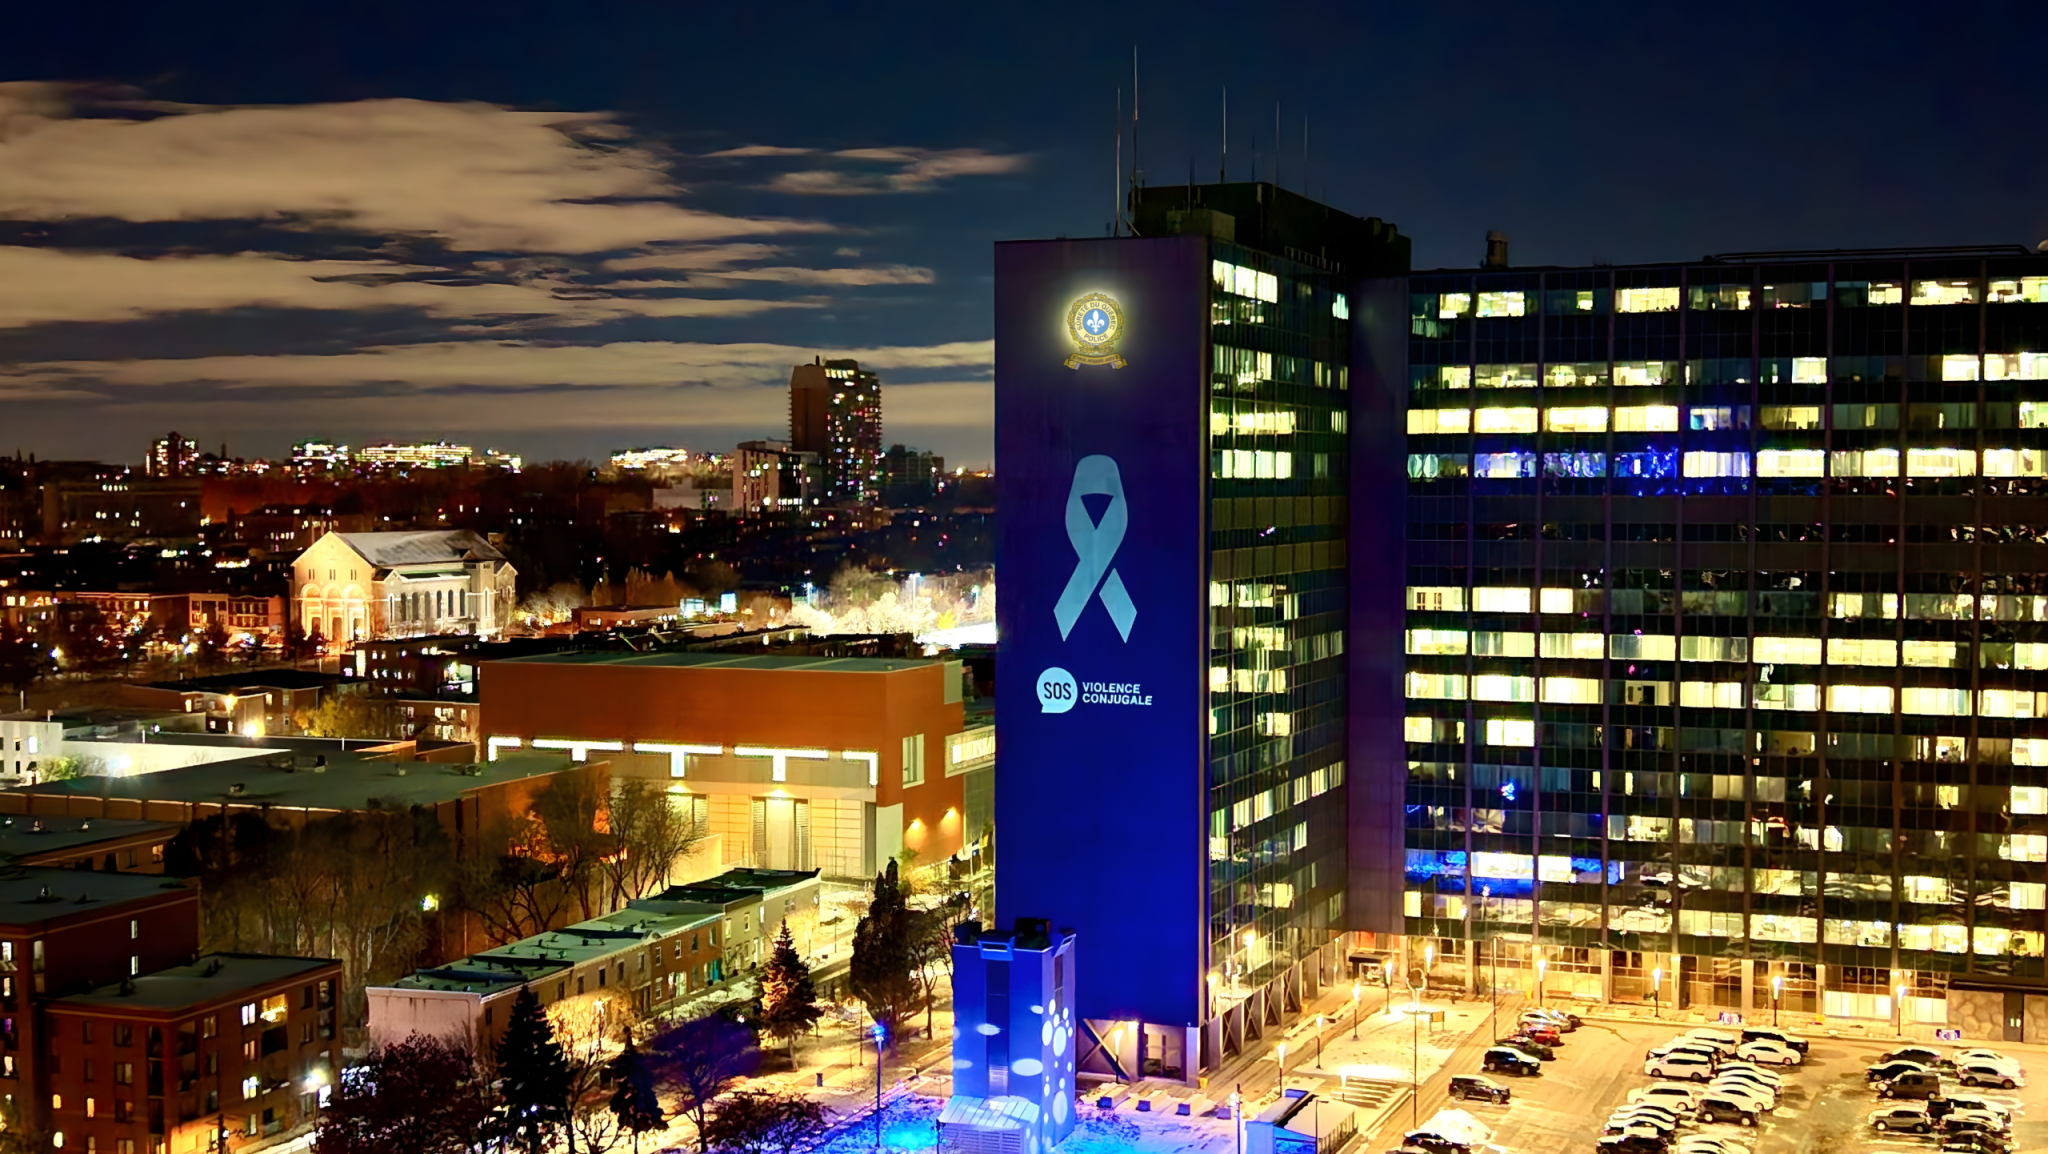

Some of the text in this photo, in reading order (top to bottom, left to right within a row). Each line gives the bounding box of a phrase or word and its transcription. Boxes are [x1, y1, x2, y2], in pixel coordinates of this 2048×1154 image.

[1084, 333, 1109, 342] POLICE
[1043, 681, 1072, 700] SOS
[1082, 681, 1141, 694] VIOLENCE
[1082, 693, 1153, 705] CONJUGALE
